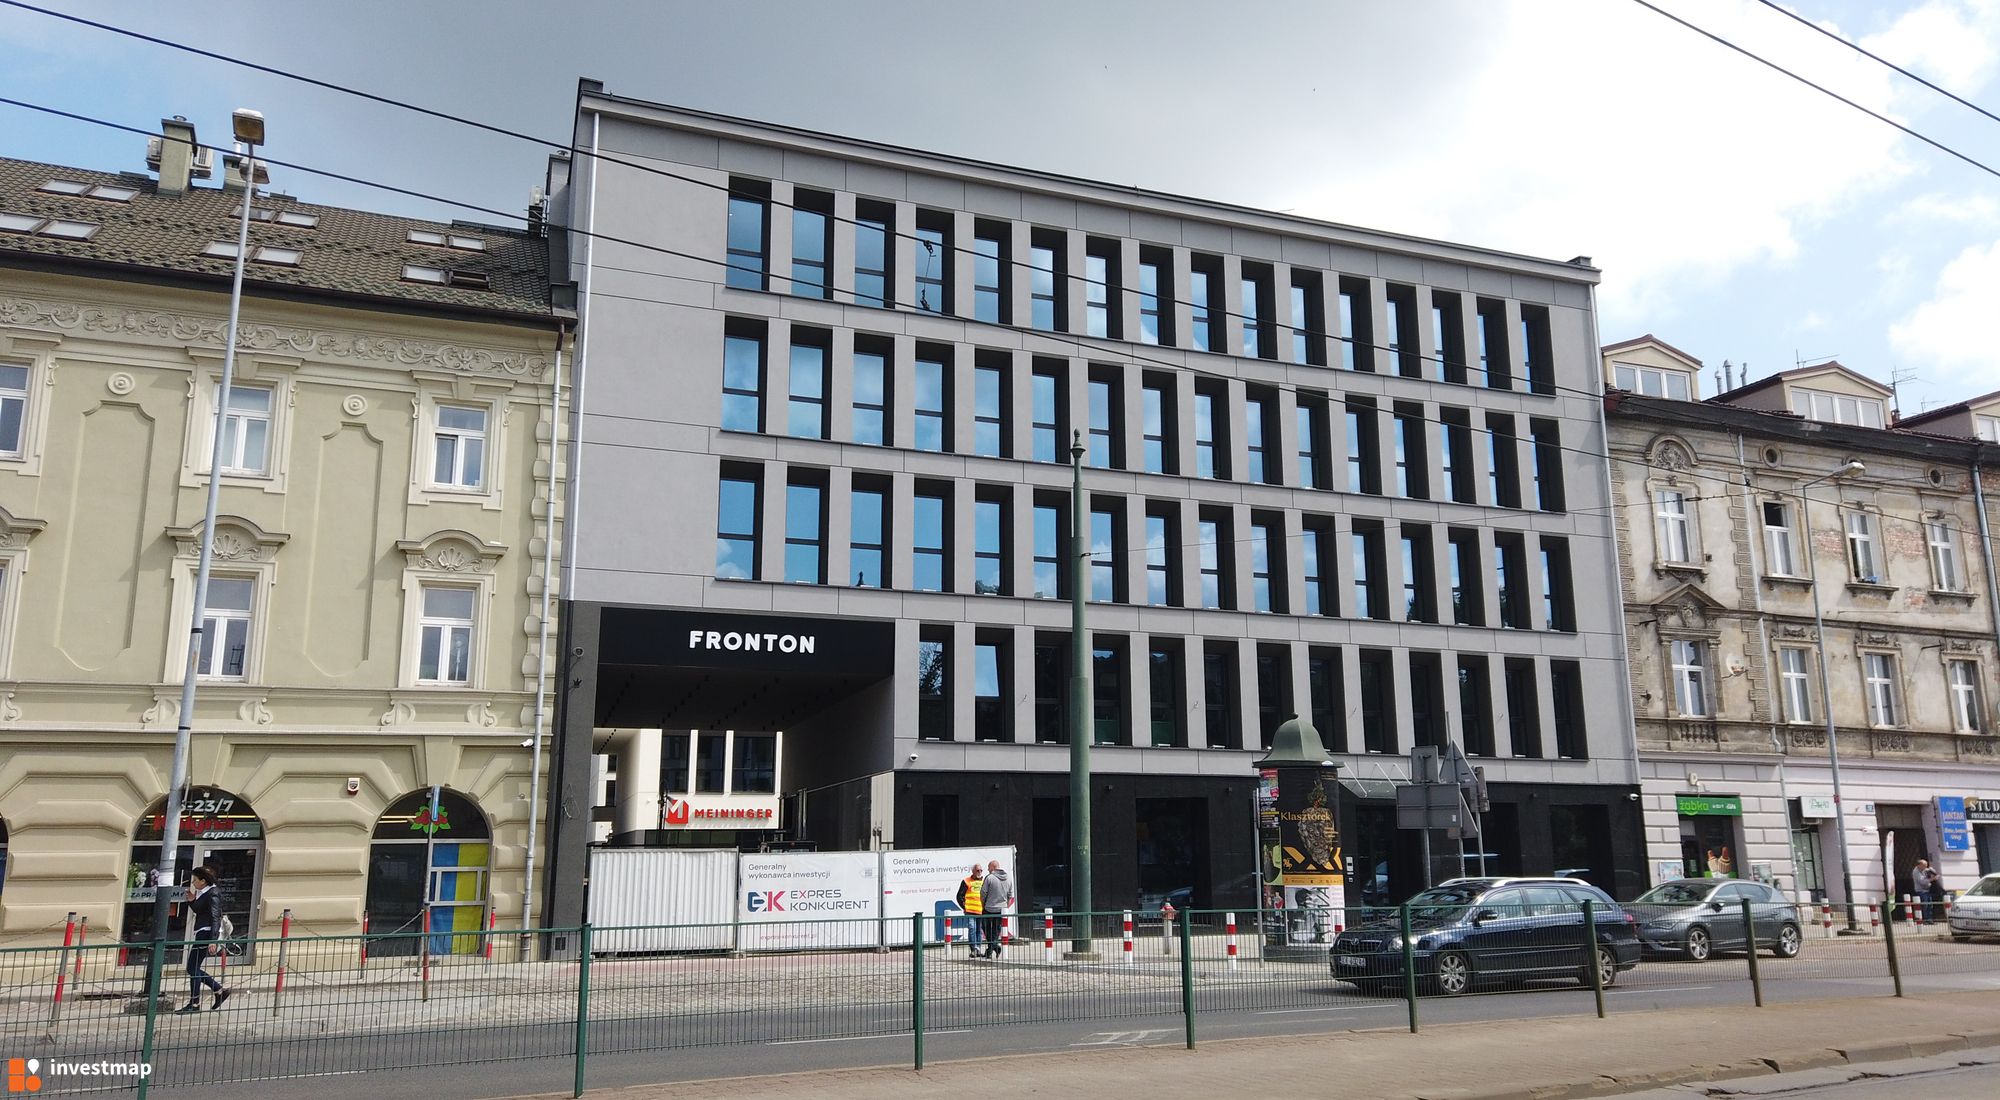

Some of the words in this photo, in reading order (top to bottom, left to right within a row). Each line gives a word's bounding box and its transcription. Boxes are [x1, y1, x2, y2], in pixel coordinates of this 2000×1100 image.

[689, 630, 815, 654] FRONTON
[1680, 799, 1709, 811] żabka
[694, 808, 773, 819] MEININGER
[202, 831, 250, 839] EXPRESS
[748, 863, 787, 871] Generalny
[893, 858, 930, 866] Generalny
[792, 870, 831, 879] inwestycji
[790, 889, 842, 899] EXPRES
[790, 900, 870, 912] KONKURENT
